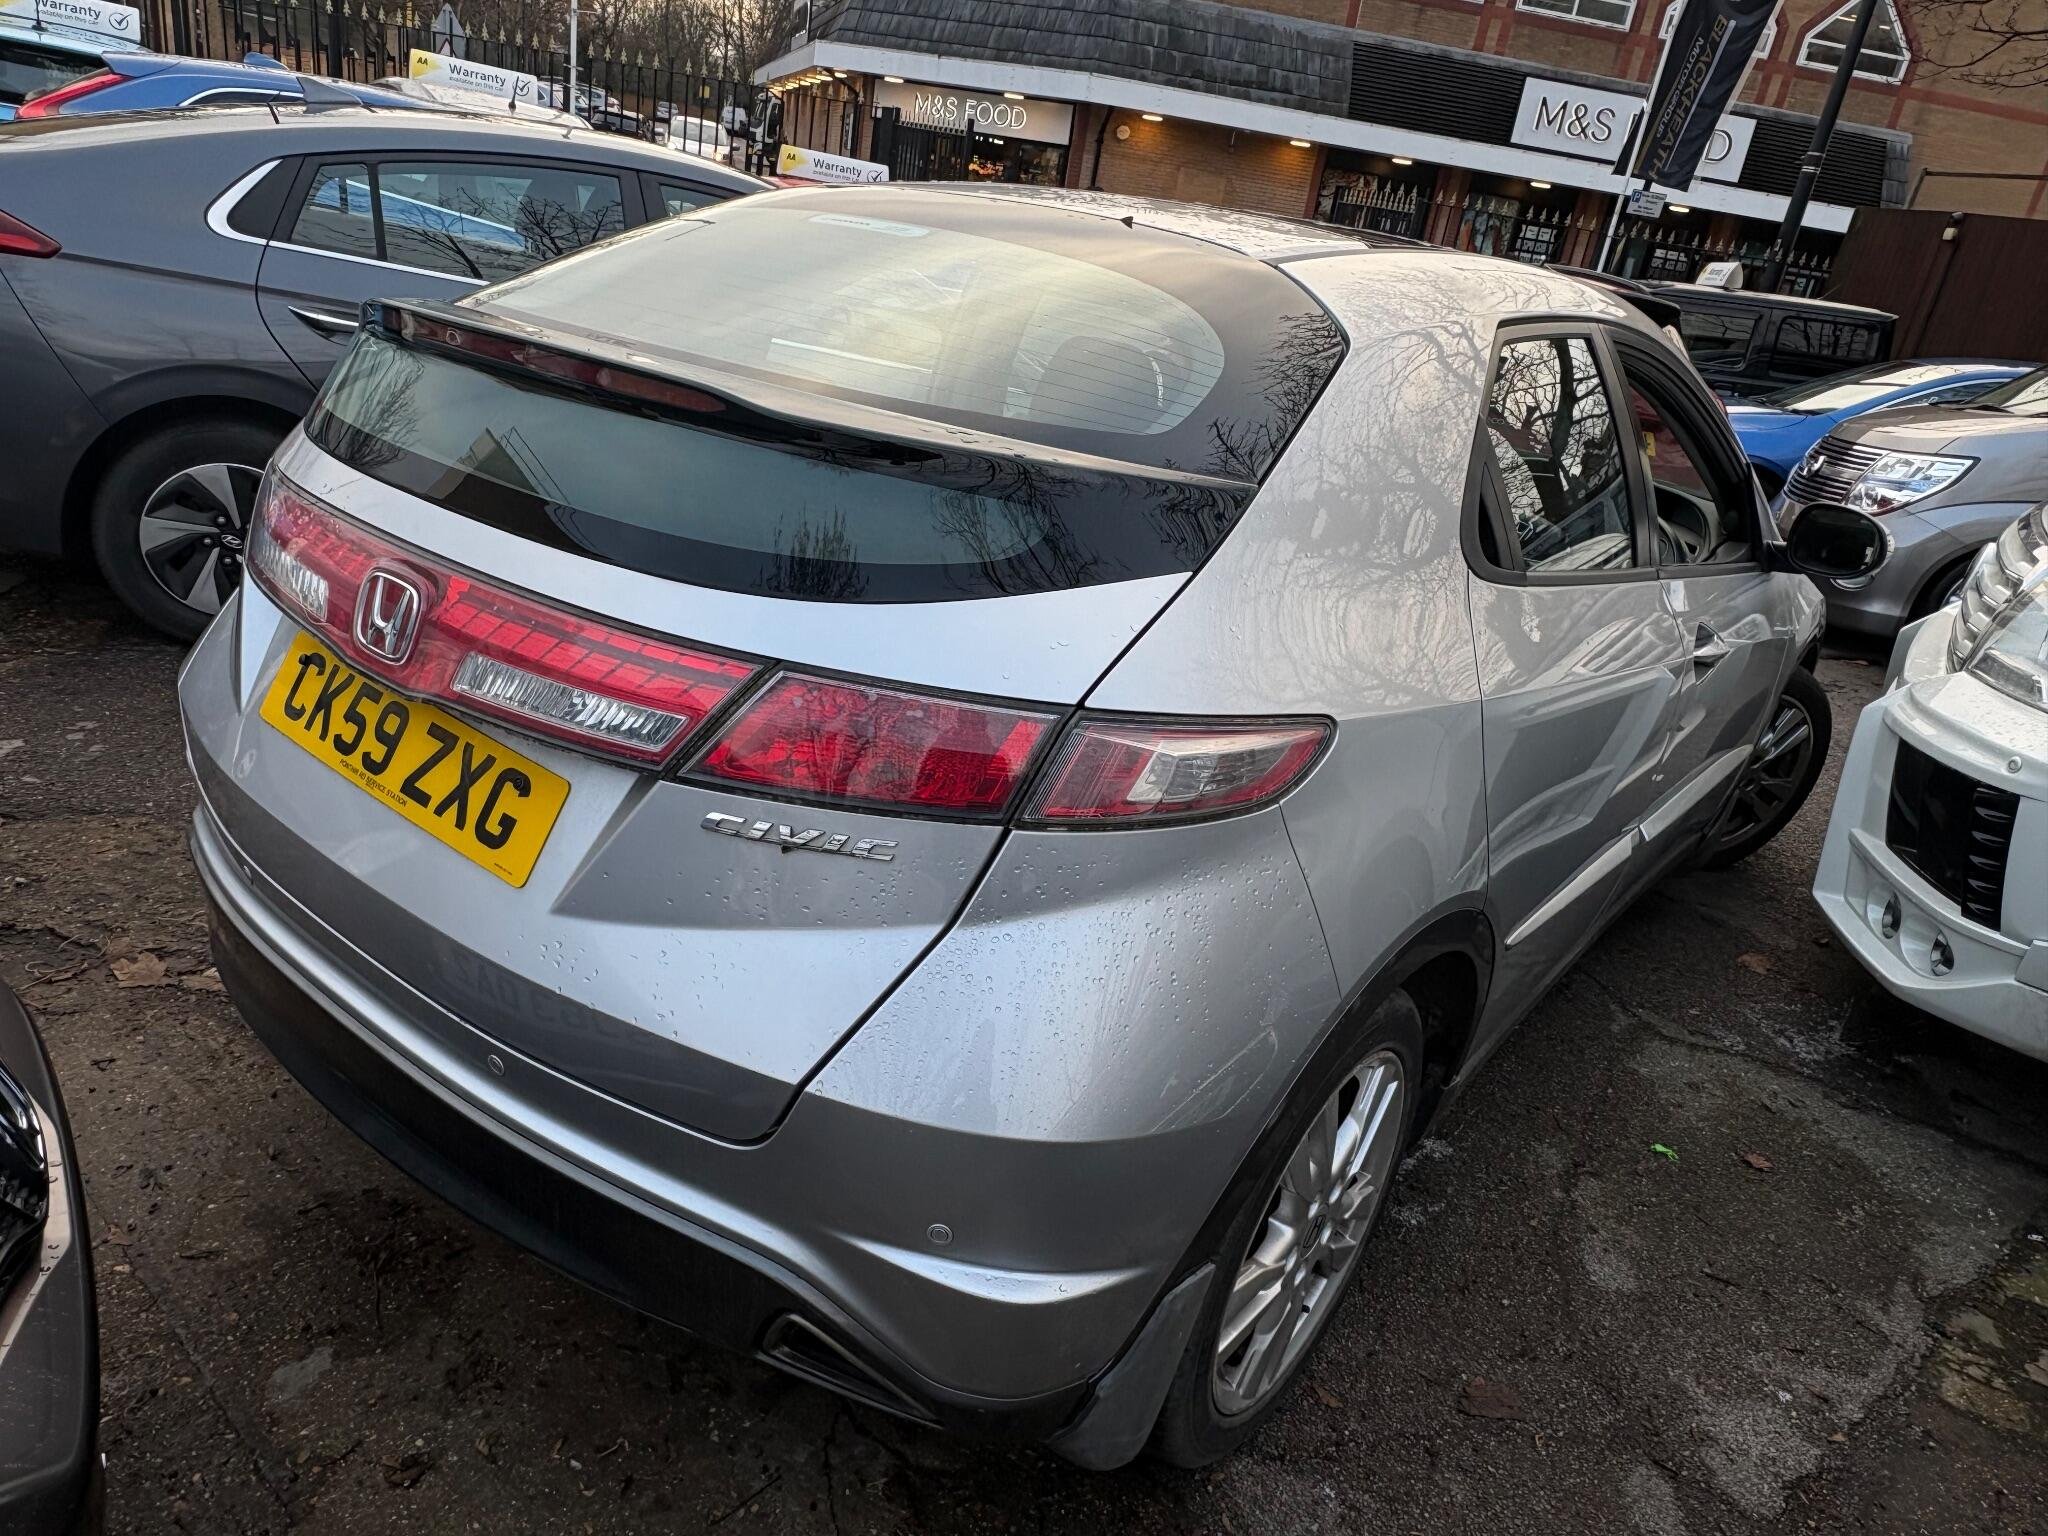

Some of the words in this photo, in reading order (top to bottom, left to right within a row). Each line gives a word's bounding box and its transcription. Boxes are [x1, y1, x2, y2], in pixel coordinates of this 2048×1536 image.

[416, 56, 428, 66] AA
[448, 63, 506, 87] Warranty
[915, 92, 958, 121] M&S
[964, 98, 1027, 129] FOOD
[1649, 14, 1727, 180] BLACKHEATH
[1532, 96, 1616, 144] M&S
[786, 152, 796, 161] AA
[813, 158, 862, 178] Warranty
[284, 652, 410, 776] CK59
[400, 722, 531, 850] ZXG
[700, 811, 899, 862] CIVIC
